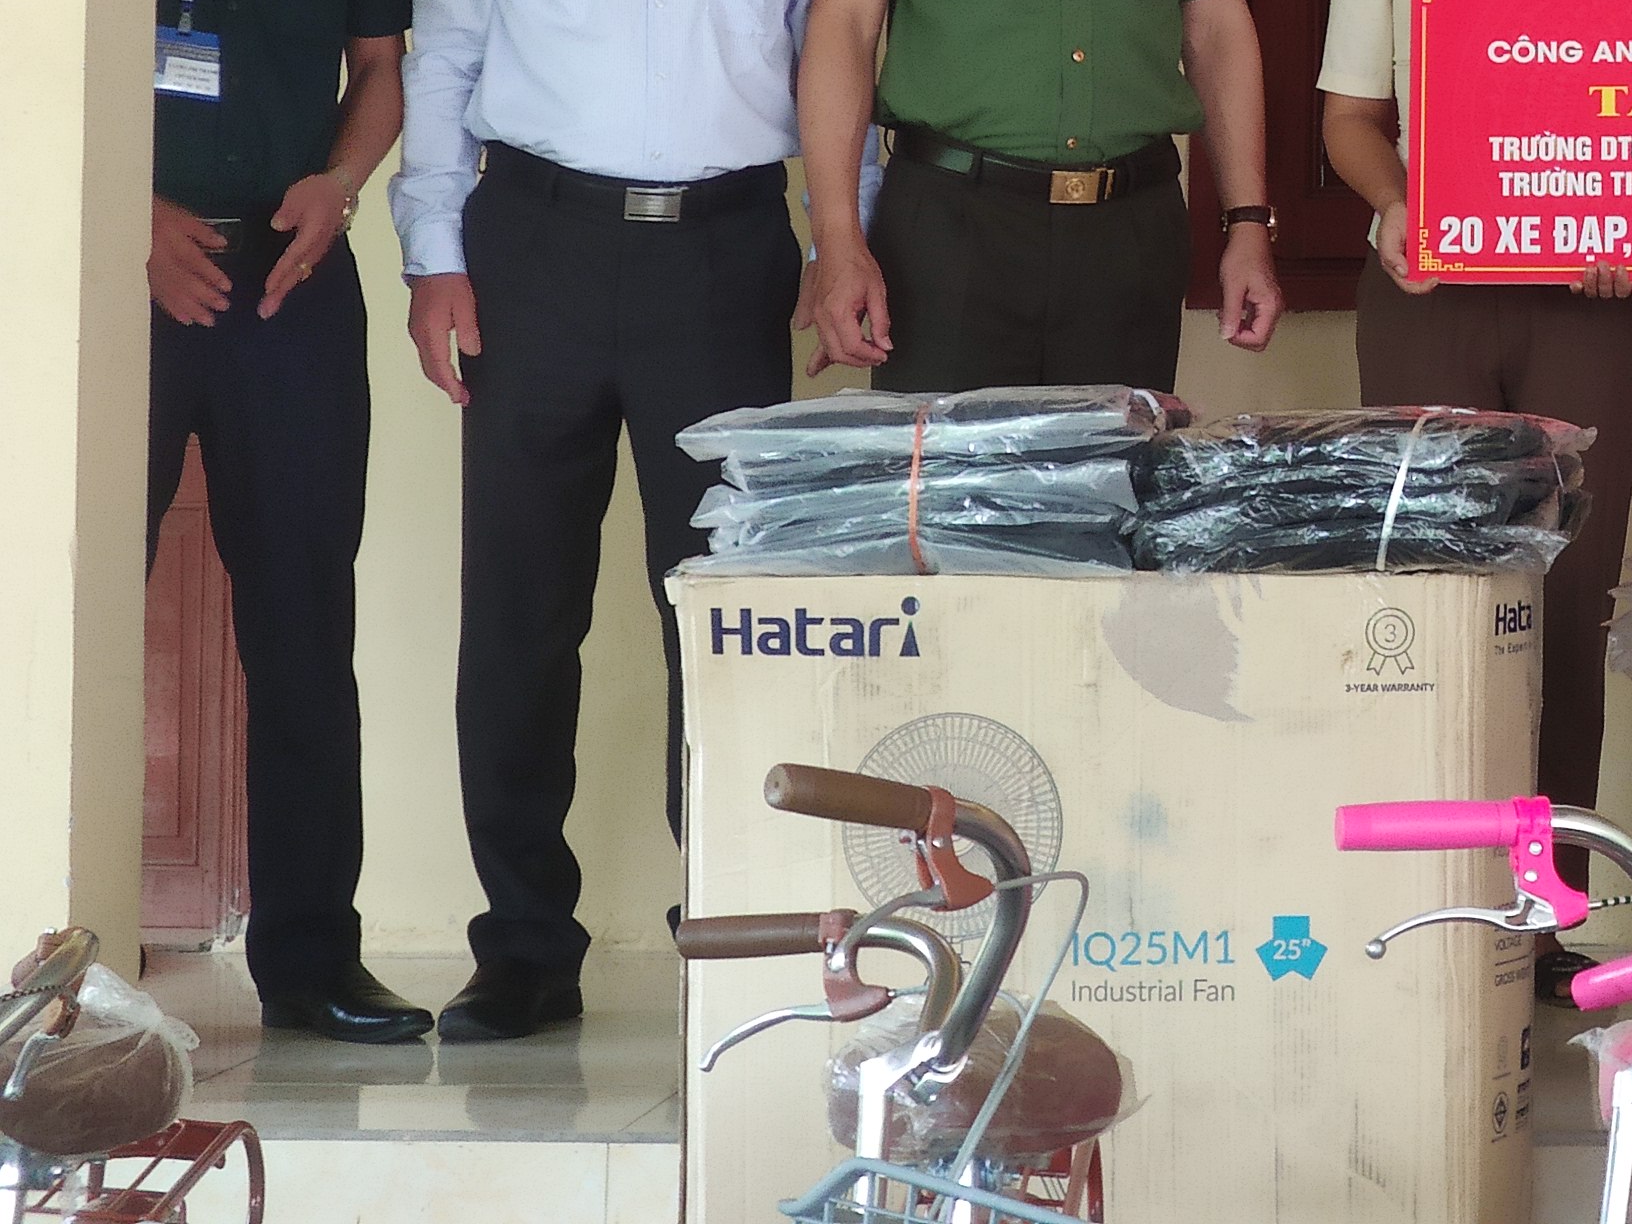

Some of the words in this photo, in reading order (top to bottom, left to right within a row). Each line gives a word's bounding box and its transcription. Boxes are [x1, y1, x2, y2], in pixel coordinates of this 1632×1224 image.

[1487, 35, 1583, 64] CÔNG
[1488, 130, 1592, 161] TRƯỜNG
[1499, 166, 1602, 197] TRƯỜNG
[1438, 215, 1483, 255] 20
[1493, 215, 1540, 253] XE
[1553, 215, 1632, 263] ĐẠP,
[710, 596, 920, 657] Hatari
[1345, 684, 1378, 693] 3-YEAR
[1381, 683, 1435, 693] WARRANTY
[1071, 930, 1235, 972] IQ25M1
[1071, 979, 1183, 1002] Industrial
[1193, 979, 1235, 1002] Fan
